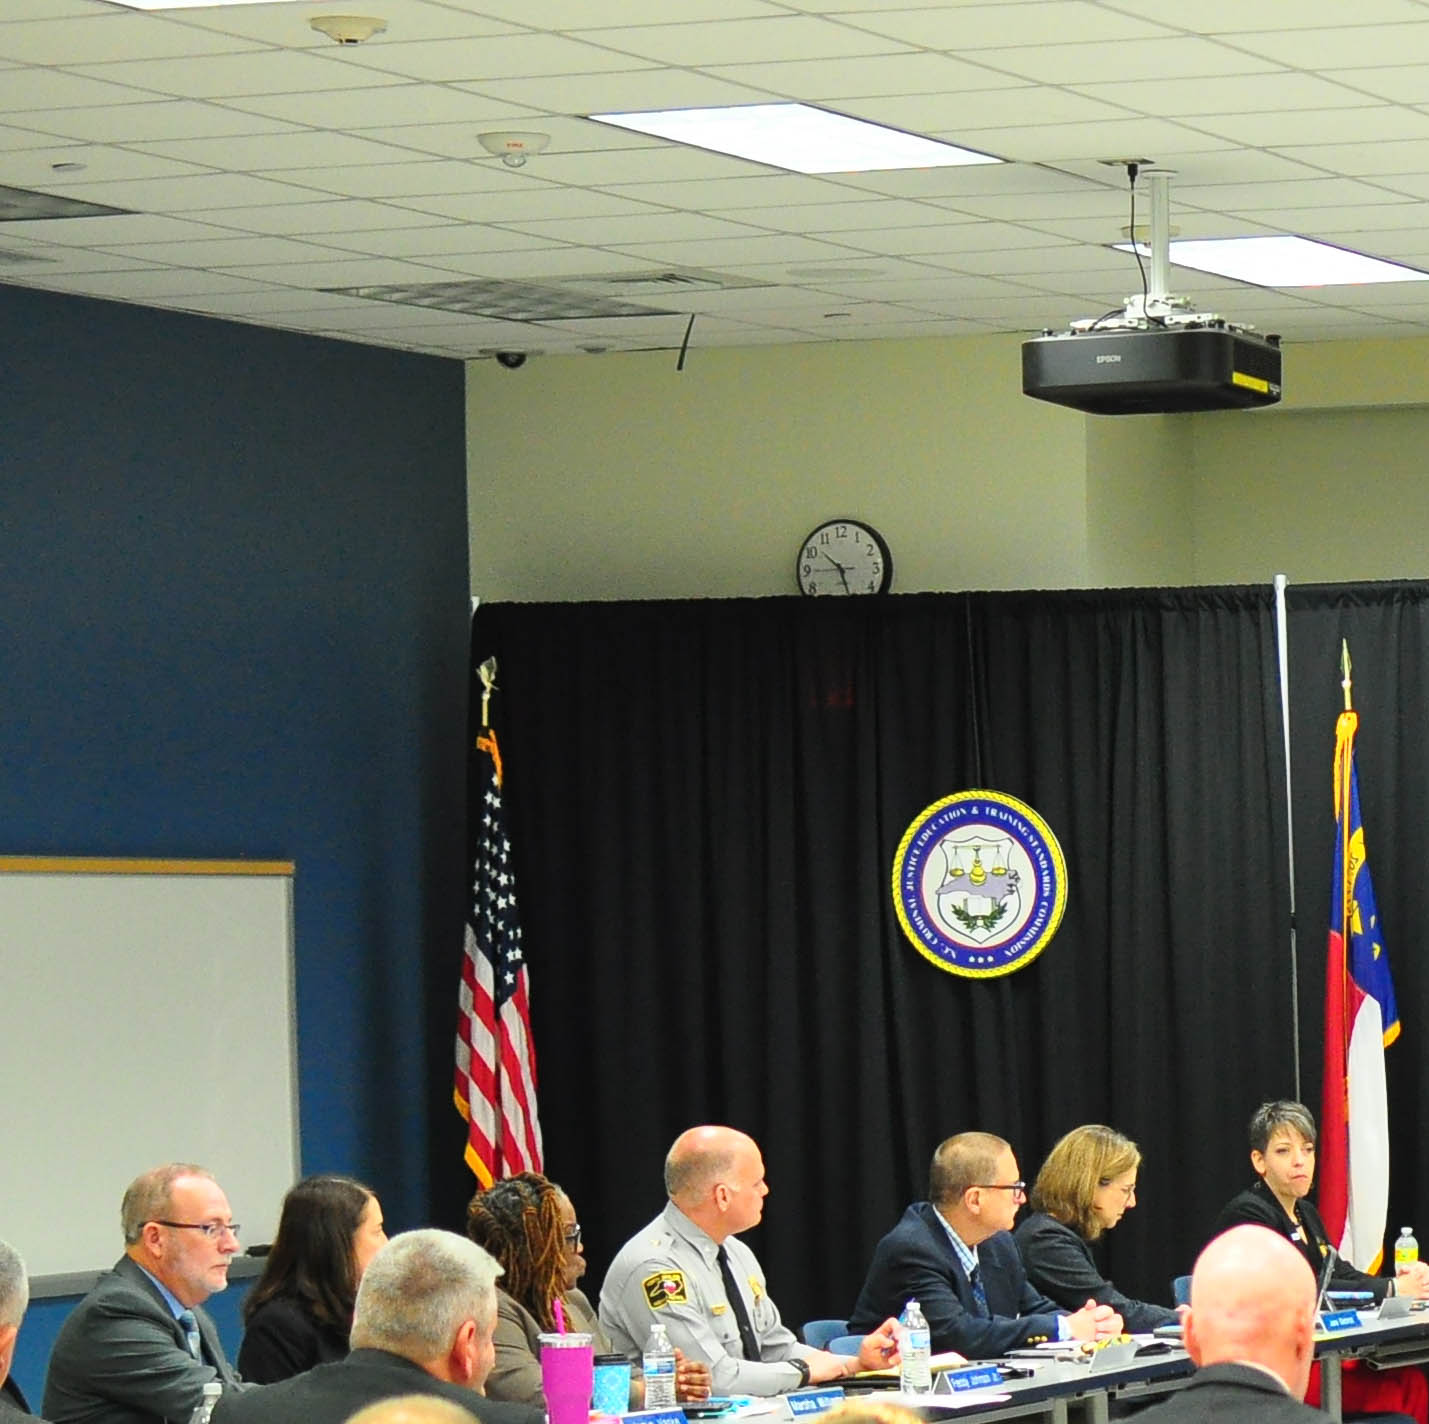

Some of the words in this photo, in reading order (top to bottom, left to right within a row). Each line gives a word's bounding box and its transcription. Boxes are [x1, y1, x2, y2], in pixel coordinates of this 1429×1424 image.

[820, 532, 830, 544] 11
[834, 526, 847, 538] 12
[855, 531, 860, 543] 1
[806, 546, 817, 558] 10
[866, 544, 874, 556] 2
[803, 564, 811, 577] 9
[872, 562, 880, 574] 3
[867, 580, 875, 593] 4
[971, 805, 980, 814] &
[919, 807, 968, 848] EDUCATION
[985, 806, 1030, 836] TRAINING
[906, 849, 922, 891] JUSTICE
[1028, 835, 1051, 897] STANDARDS
[907, 895, 938, 945] CRIMINAL
[1005, 902, 1049, 957] COMMISSION
